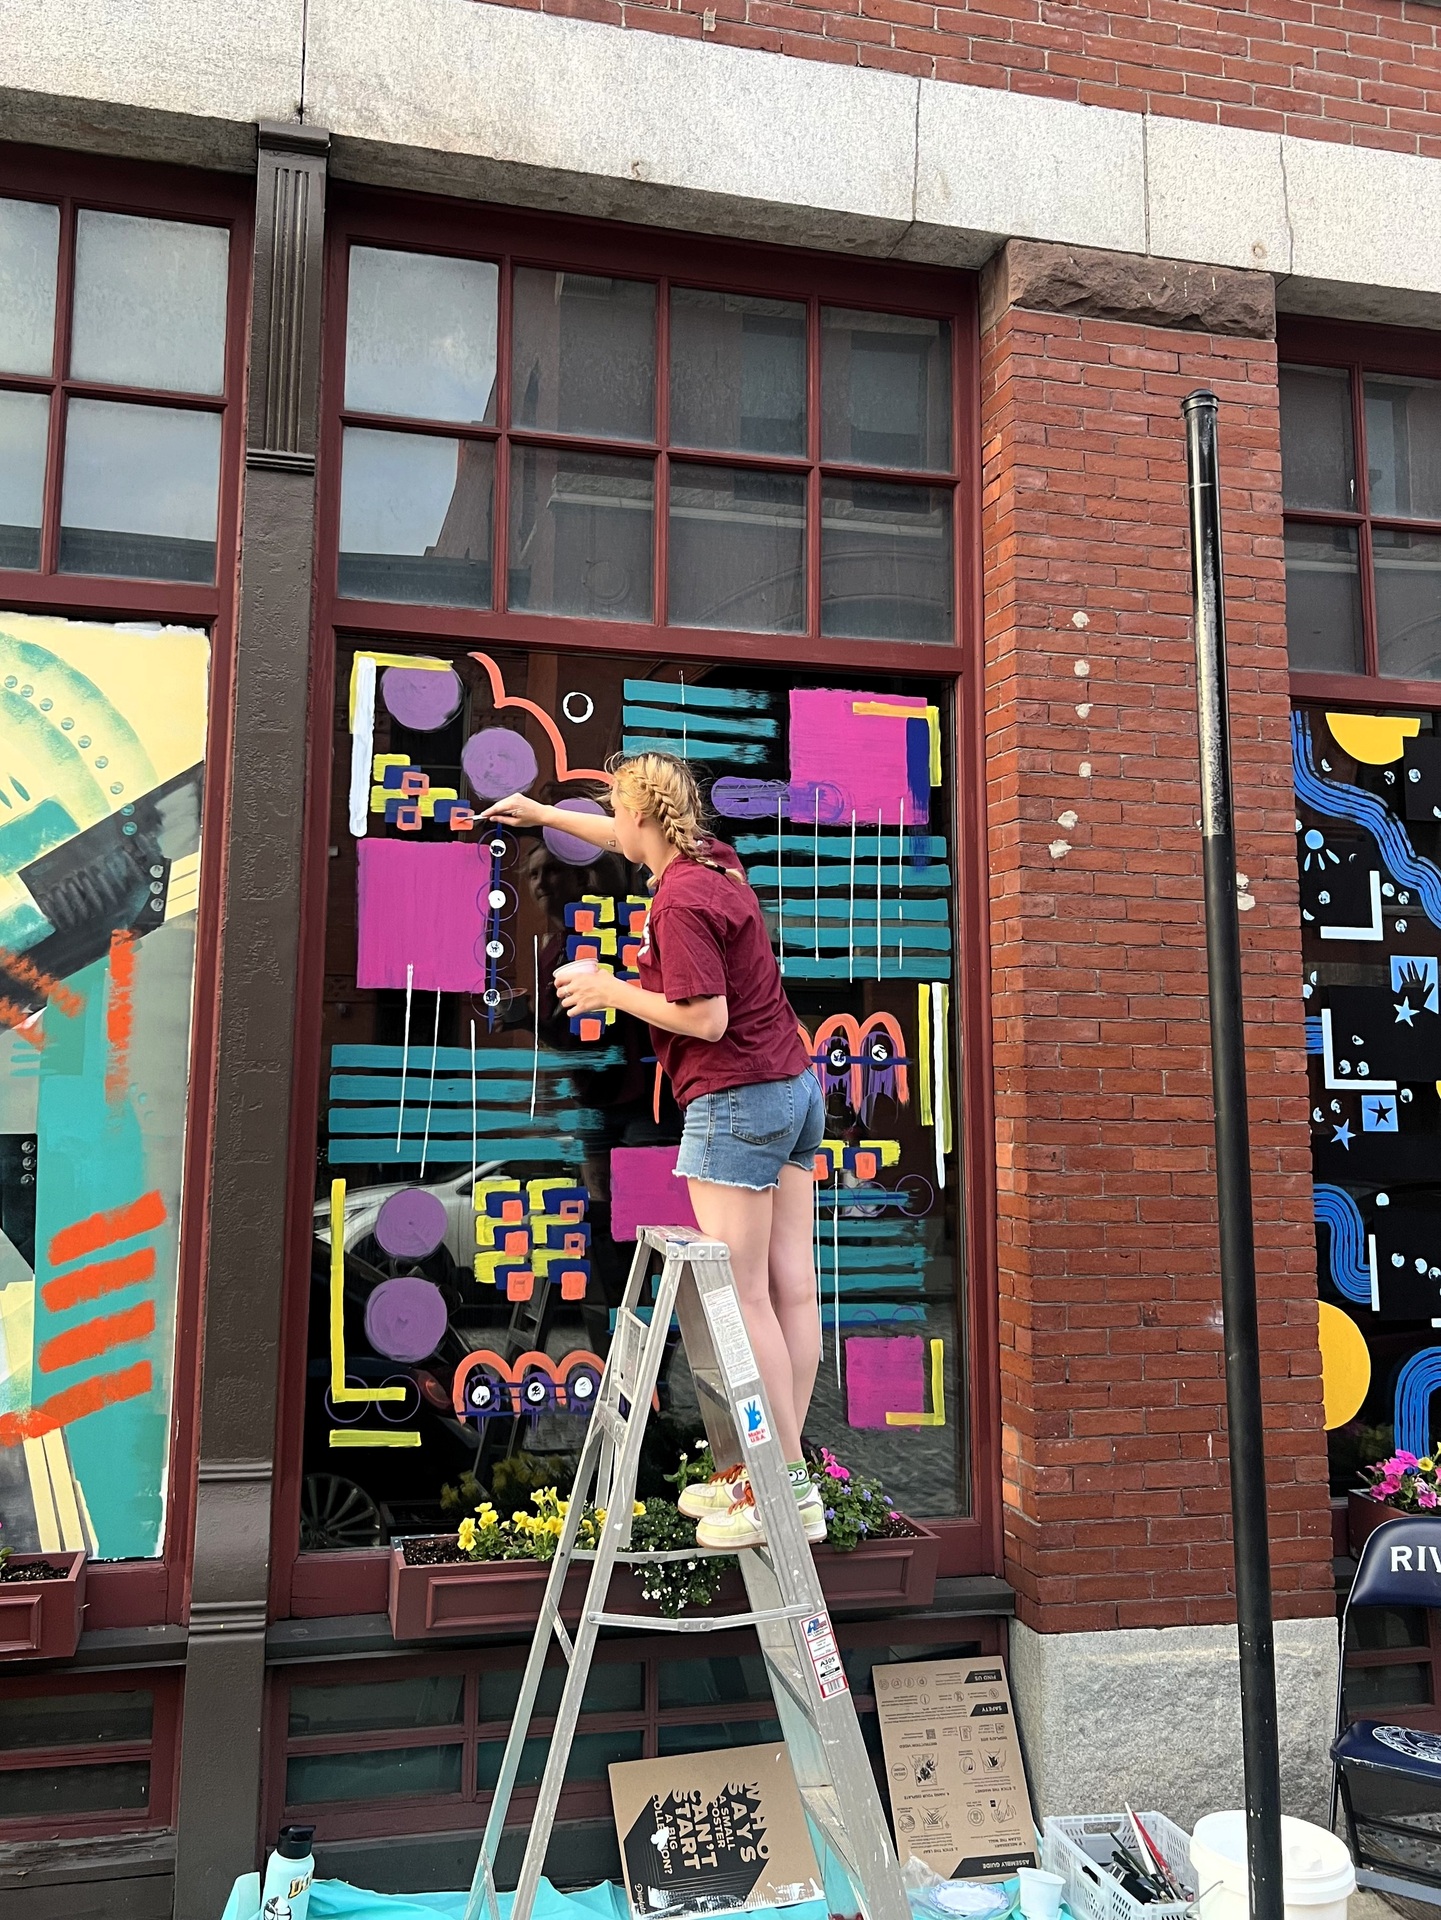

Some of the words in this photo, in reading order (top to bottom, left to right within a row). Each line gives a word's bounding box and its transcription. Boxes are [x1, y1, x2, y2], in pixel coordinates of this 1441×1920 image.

[748, 1430, 761, 1438] Made
[665, 1814, 673, 1824] A
[719, 1795, 727, 1805] A
[743, 1781, 770, 1860] WHO
[668, 1826, 678, 1850] BIG
[672, 1789, 701, 1870] START
[709, 1800, 725, 1848] POSTER
[721, 1807, 736, 1851] SMALL
[727, 1782, 757, 1863] SAYS
